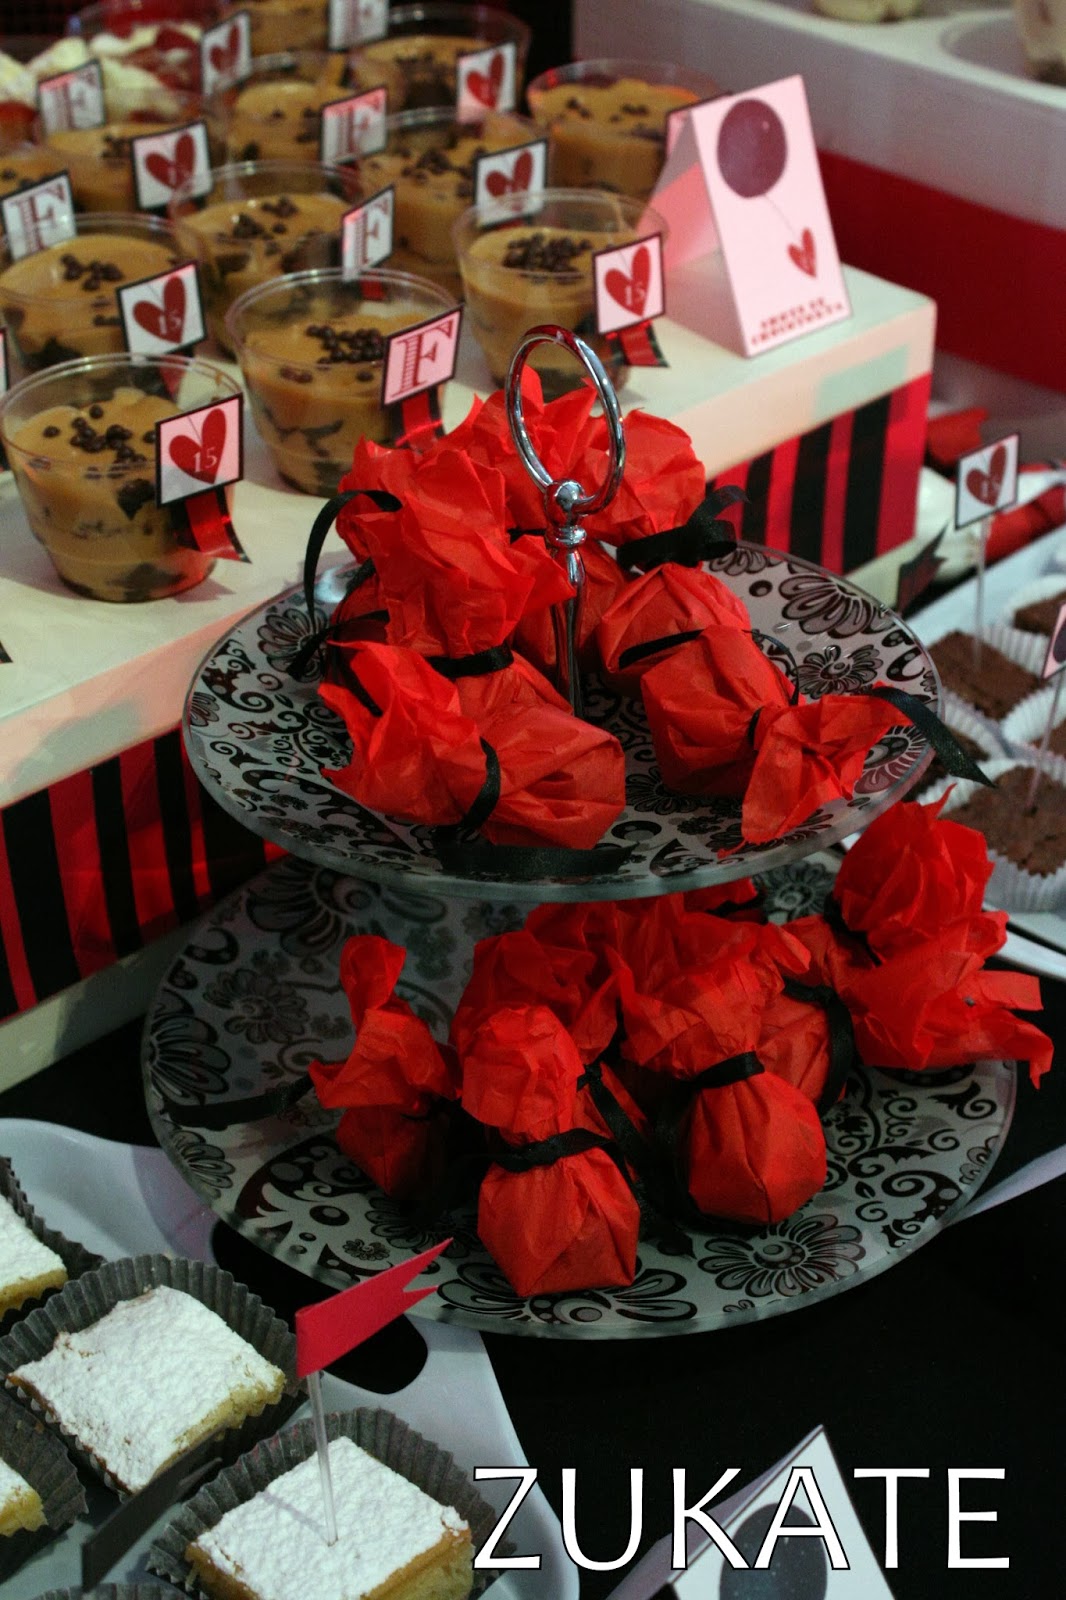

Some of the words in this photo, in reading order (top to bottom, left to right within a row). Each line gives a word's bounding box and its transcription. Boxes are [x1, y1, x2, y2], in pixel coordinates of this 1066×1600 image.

[9, 183, 66, 256] F
[350, 196, 389, 268] F
[625, 281, 647, 307] 15
[157, 309, 183, 336] 15
[391, 319, 453, 398] F
[193, 446, 218, 473] 15
